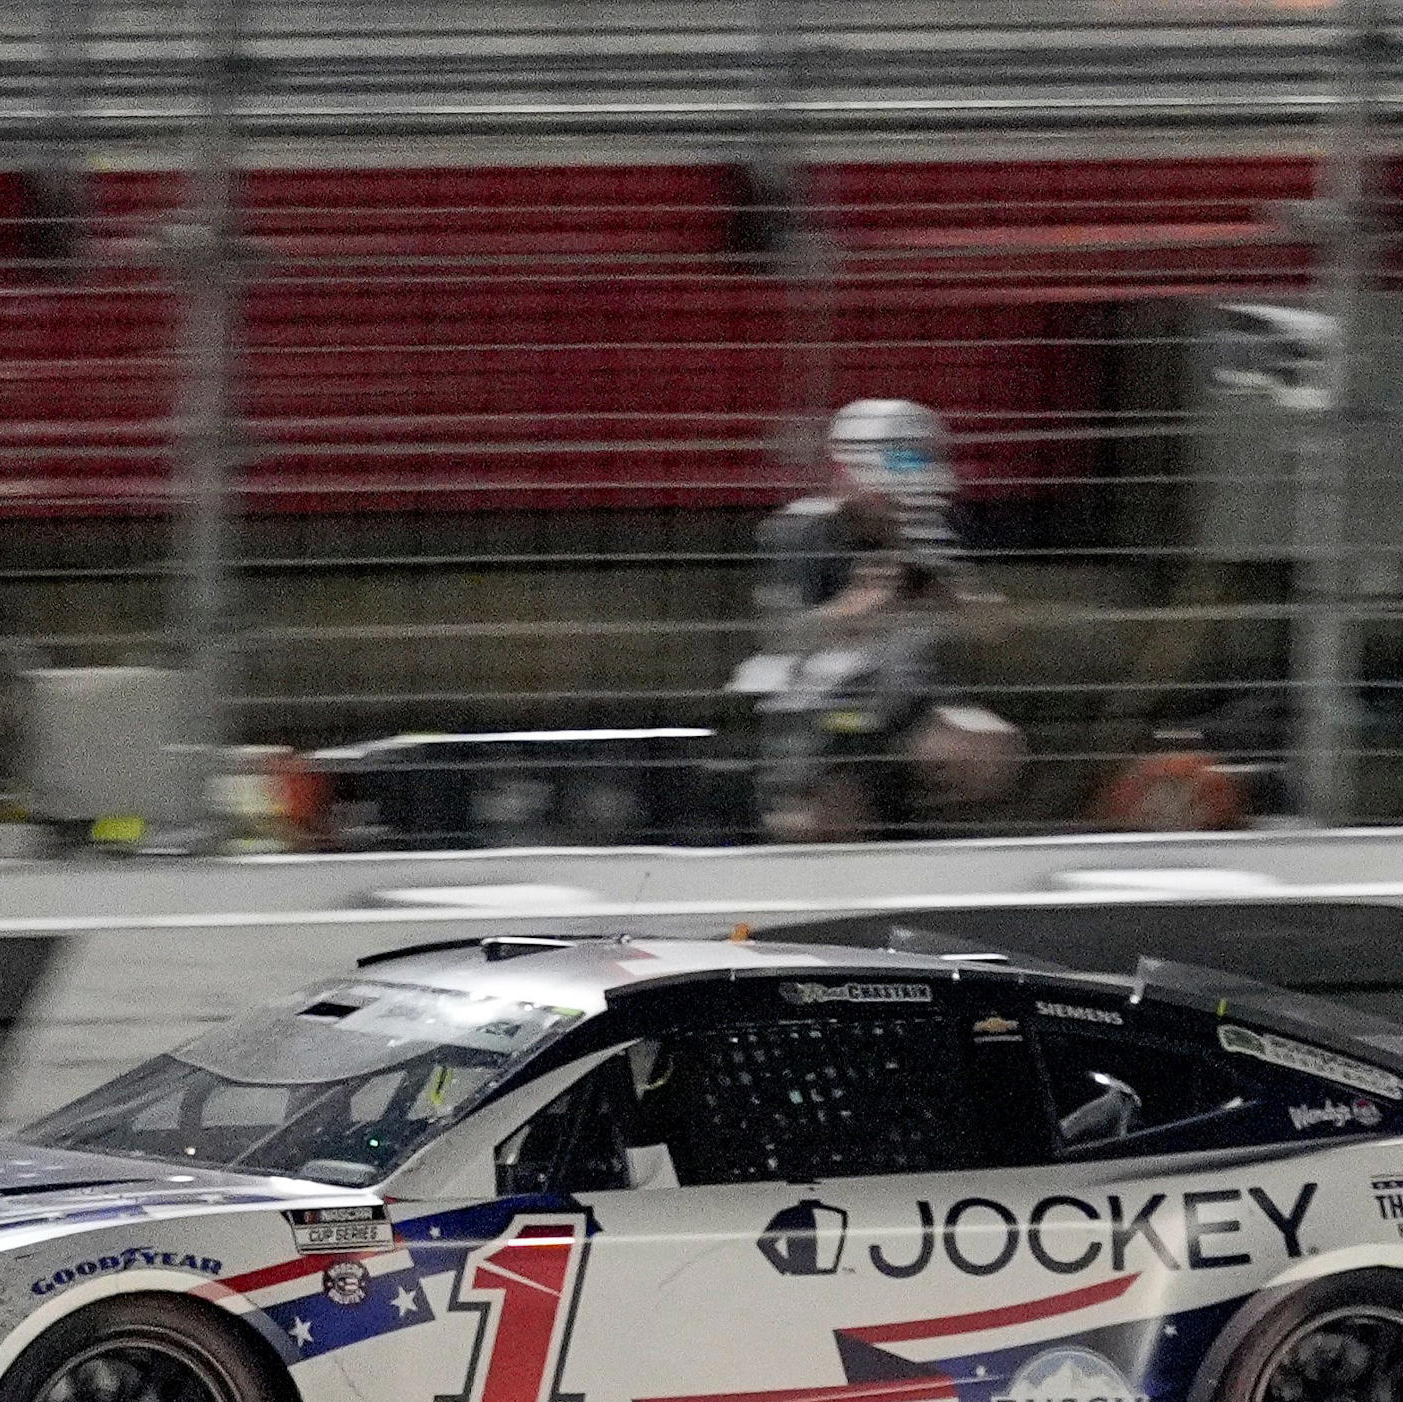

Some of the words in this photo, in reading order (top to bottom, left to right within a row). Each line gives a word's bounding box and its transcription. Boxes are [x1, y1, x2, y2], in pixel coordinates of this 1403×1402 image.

[1035, 1001, 1123, 1025] SIEMENS
[309, 1227, 334, 1242] CUP
[336, 1225, 378, 1241] SERIES
[868, 1182, 1318, 1278] JOCKEY
[30, 1247, 223, 1295] GOODYEAR
